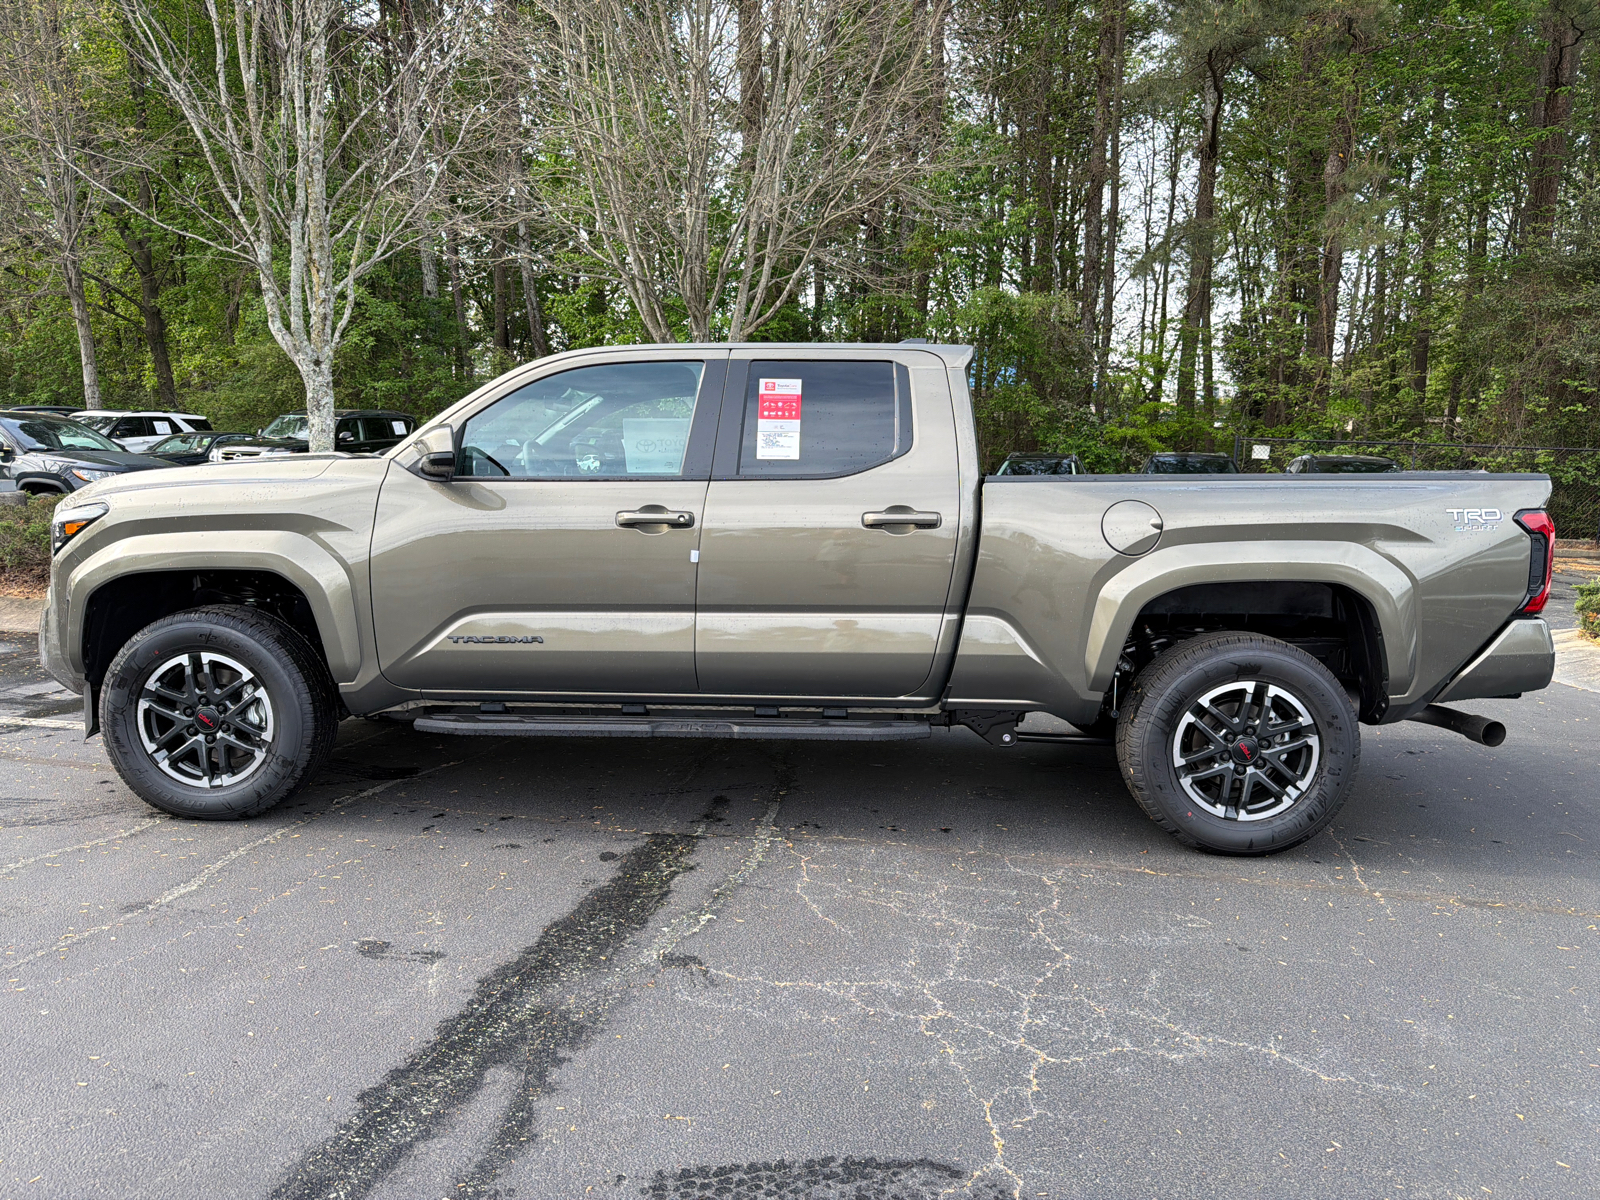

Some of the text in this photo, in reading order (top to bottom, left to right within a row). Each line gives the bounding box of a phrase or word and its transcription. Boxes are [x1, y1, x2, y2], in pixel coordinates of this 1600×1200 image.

[1445, 508, 1503, 525] TRD
[447, 635, 544, 644] TACOMA
[198, 713, 214, 727] TRD
[1239, 742, 1252, 760] TRD
